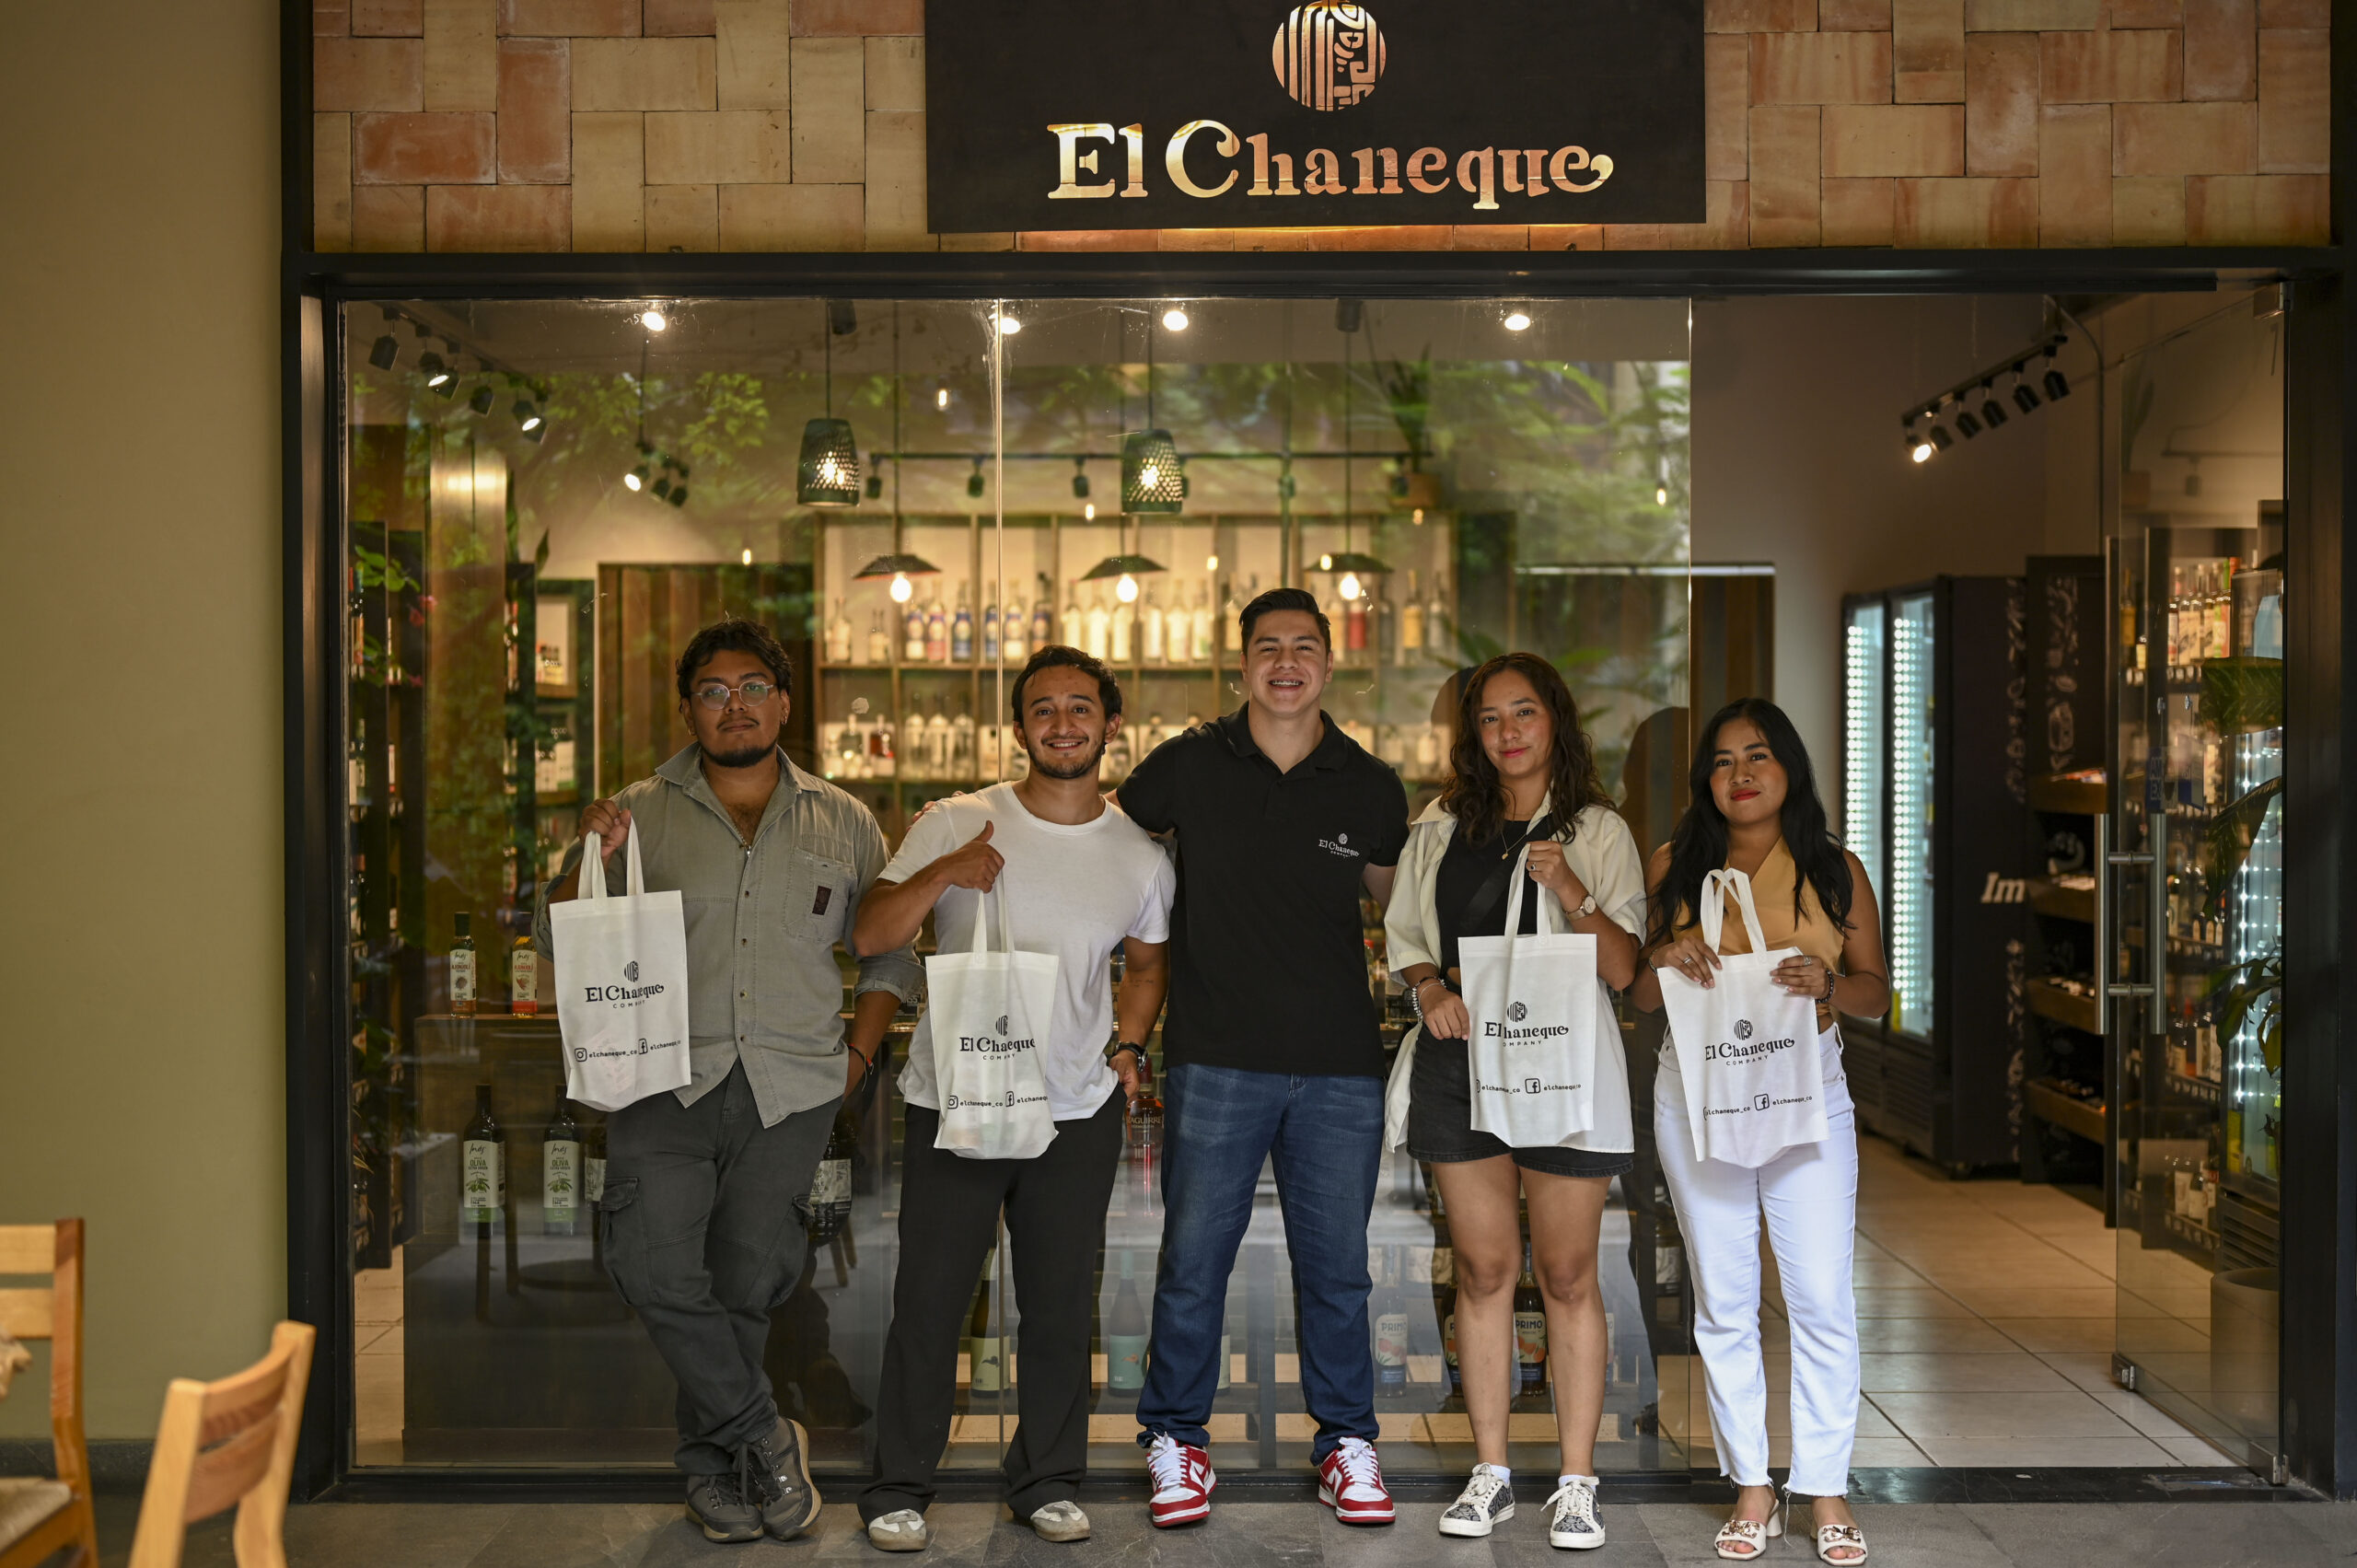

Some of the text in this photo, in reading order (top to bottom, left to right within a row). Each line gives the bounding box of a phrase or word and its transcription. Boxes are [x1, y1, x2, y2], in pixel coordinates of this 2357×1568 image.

[1047, 119, 1614, 210] El Chaneque
[1318, 839, 1328, 848] El
[584, 986, 603, 1003] El
[1484, 1021, 1570, 1039] El haneque
[959, 1037, 974, 1051] El
[1704, 1038, 1795, 1061] El Chaneque
[1725, 1054, 1769, 1066] COMPANY
[1515, 1319, 1543, 1330] PRIMO
